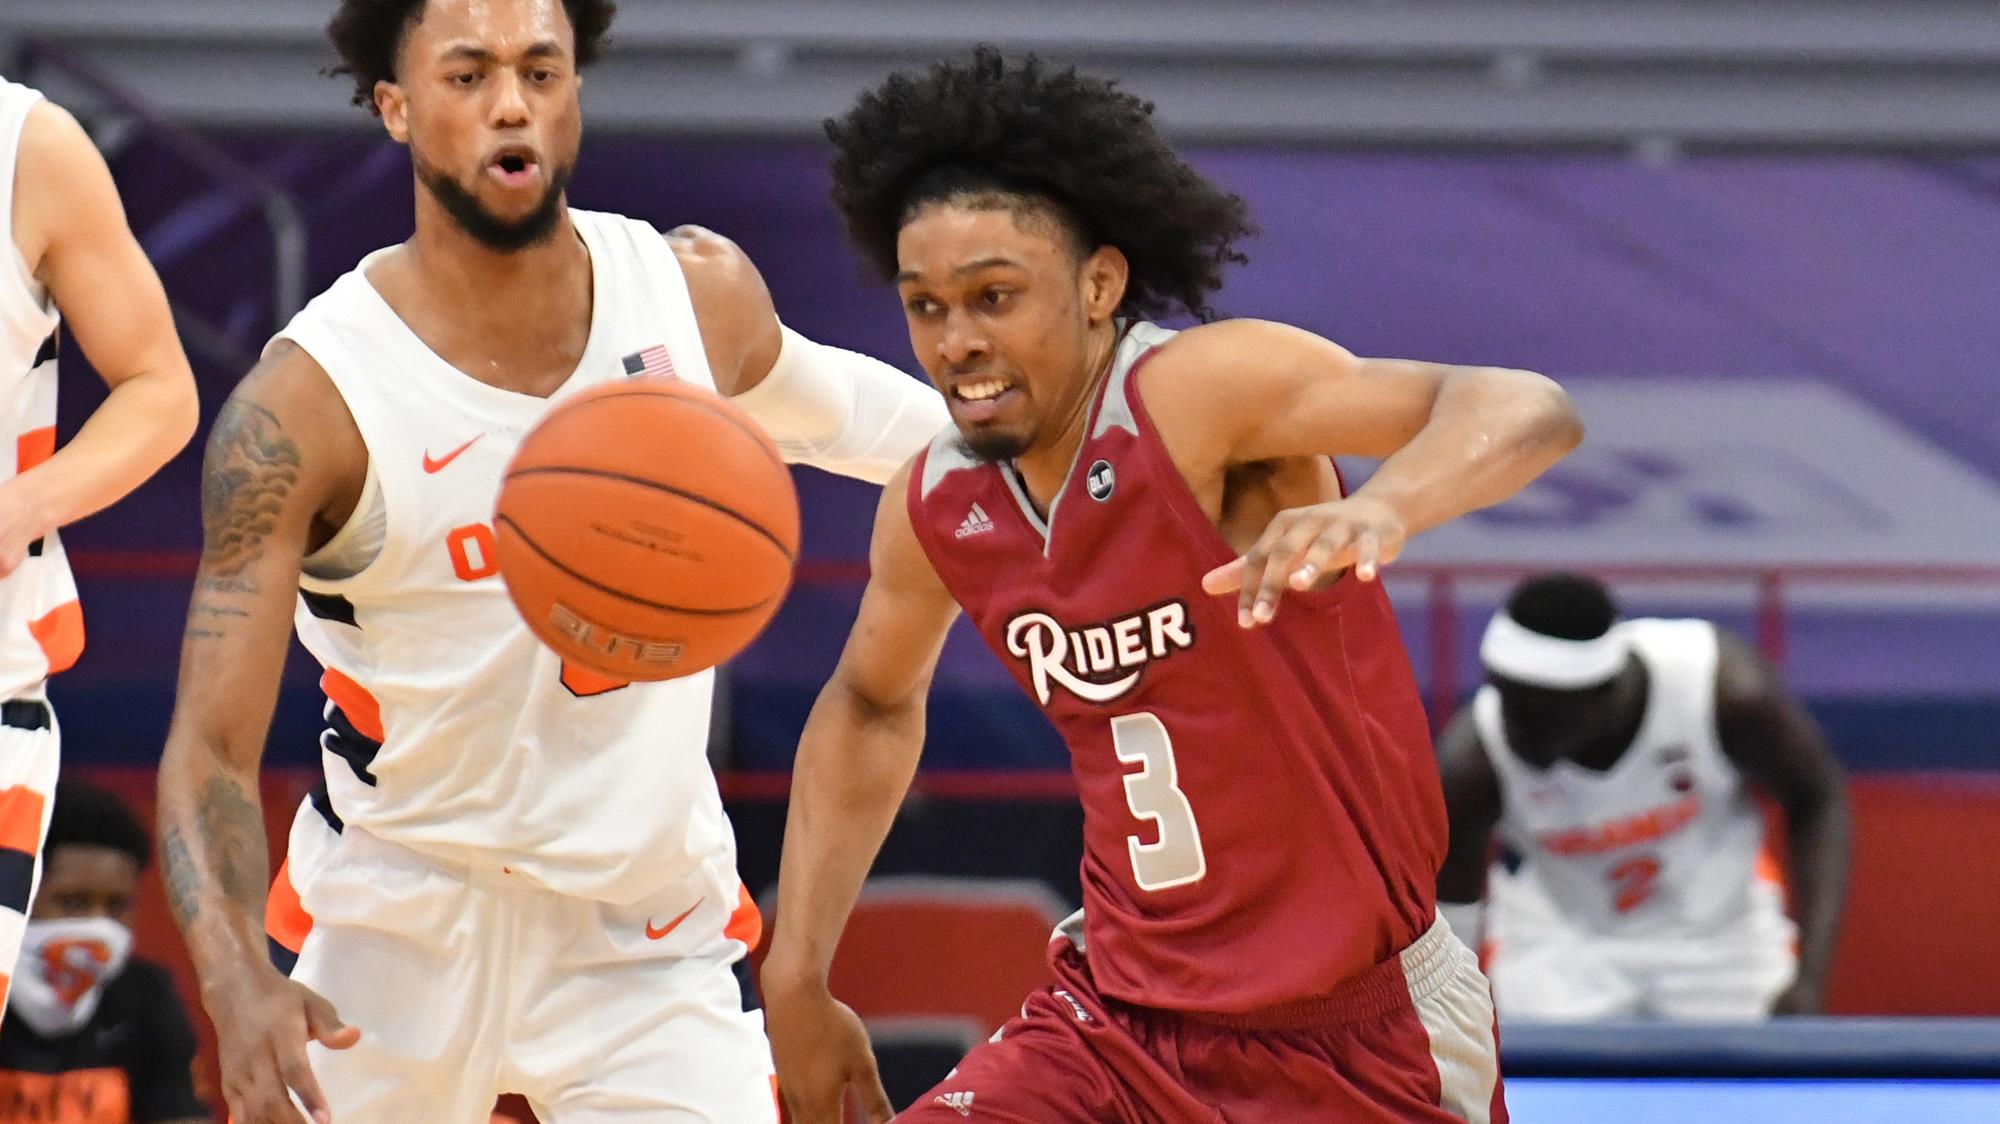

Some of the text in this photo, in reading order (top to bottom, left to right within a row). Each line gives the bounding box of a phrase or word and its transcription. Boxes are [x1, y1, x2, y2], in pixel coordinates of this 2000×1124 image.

[1090, 469, 1112, 494] BLM
[954, 521, 994, 539] adidas
[1110, 711, 1207, 891] 3
